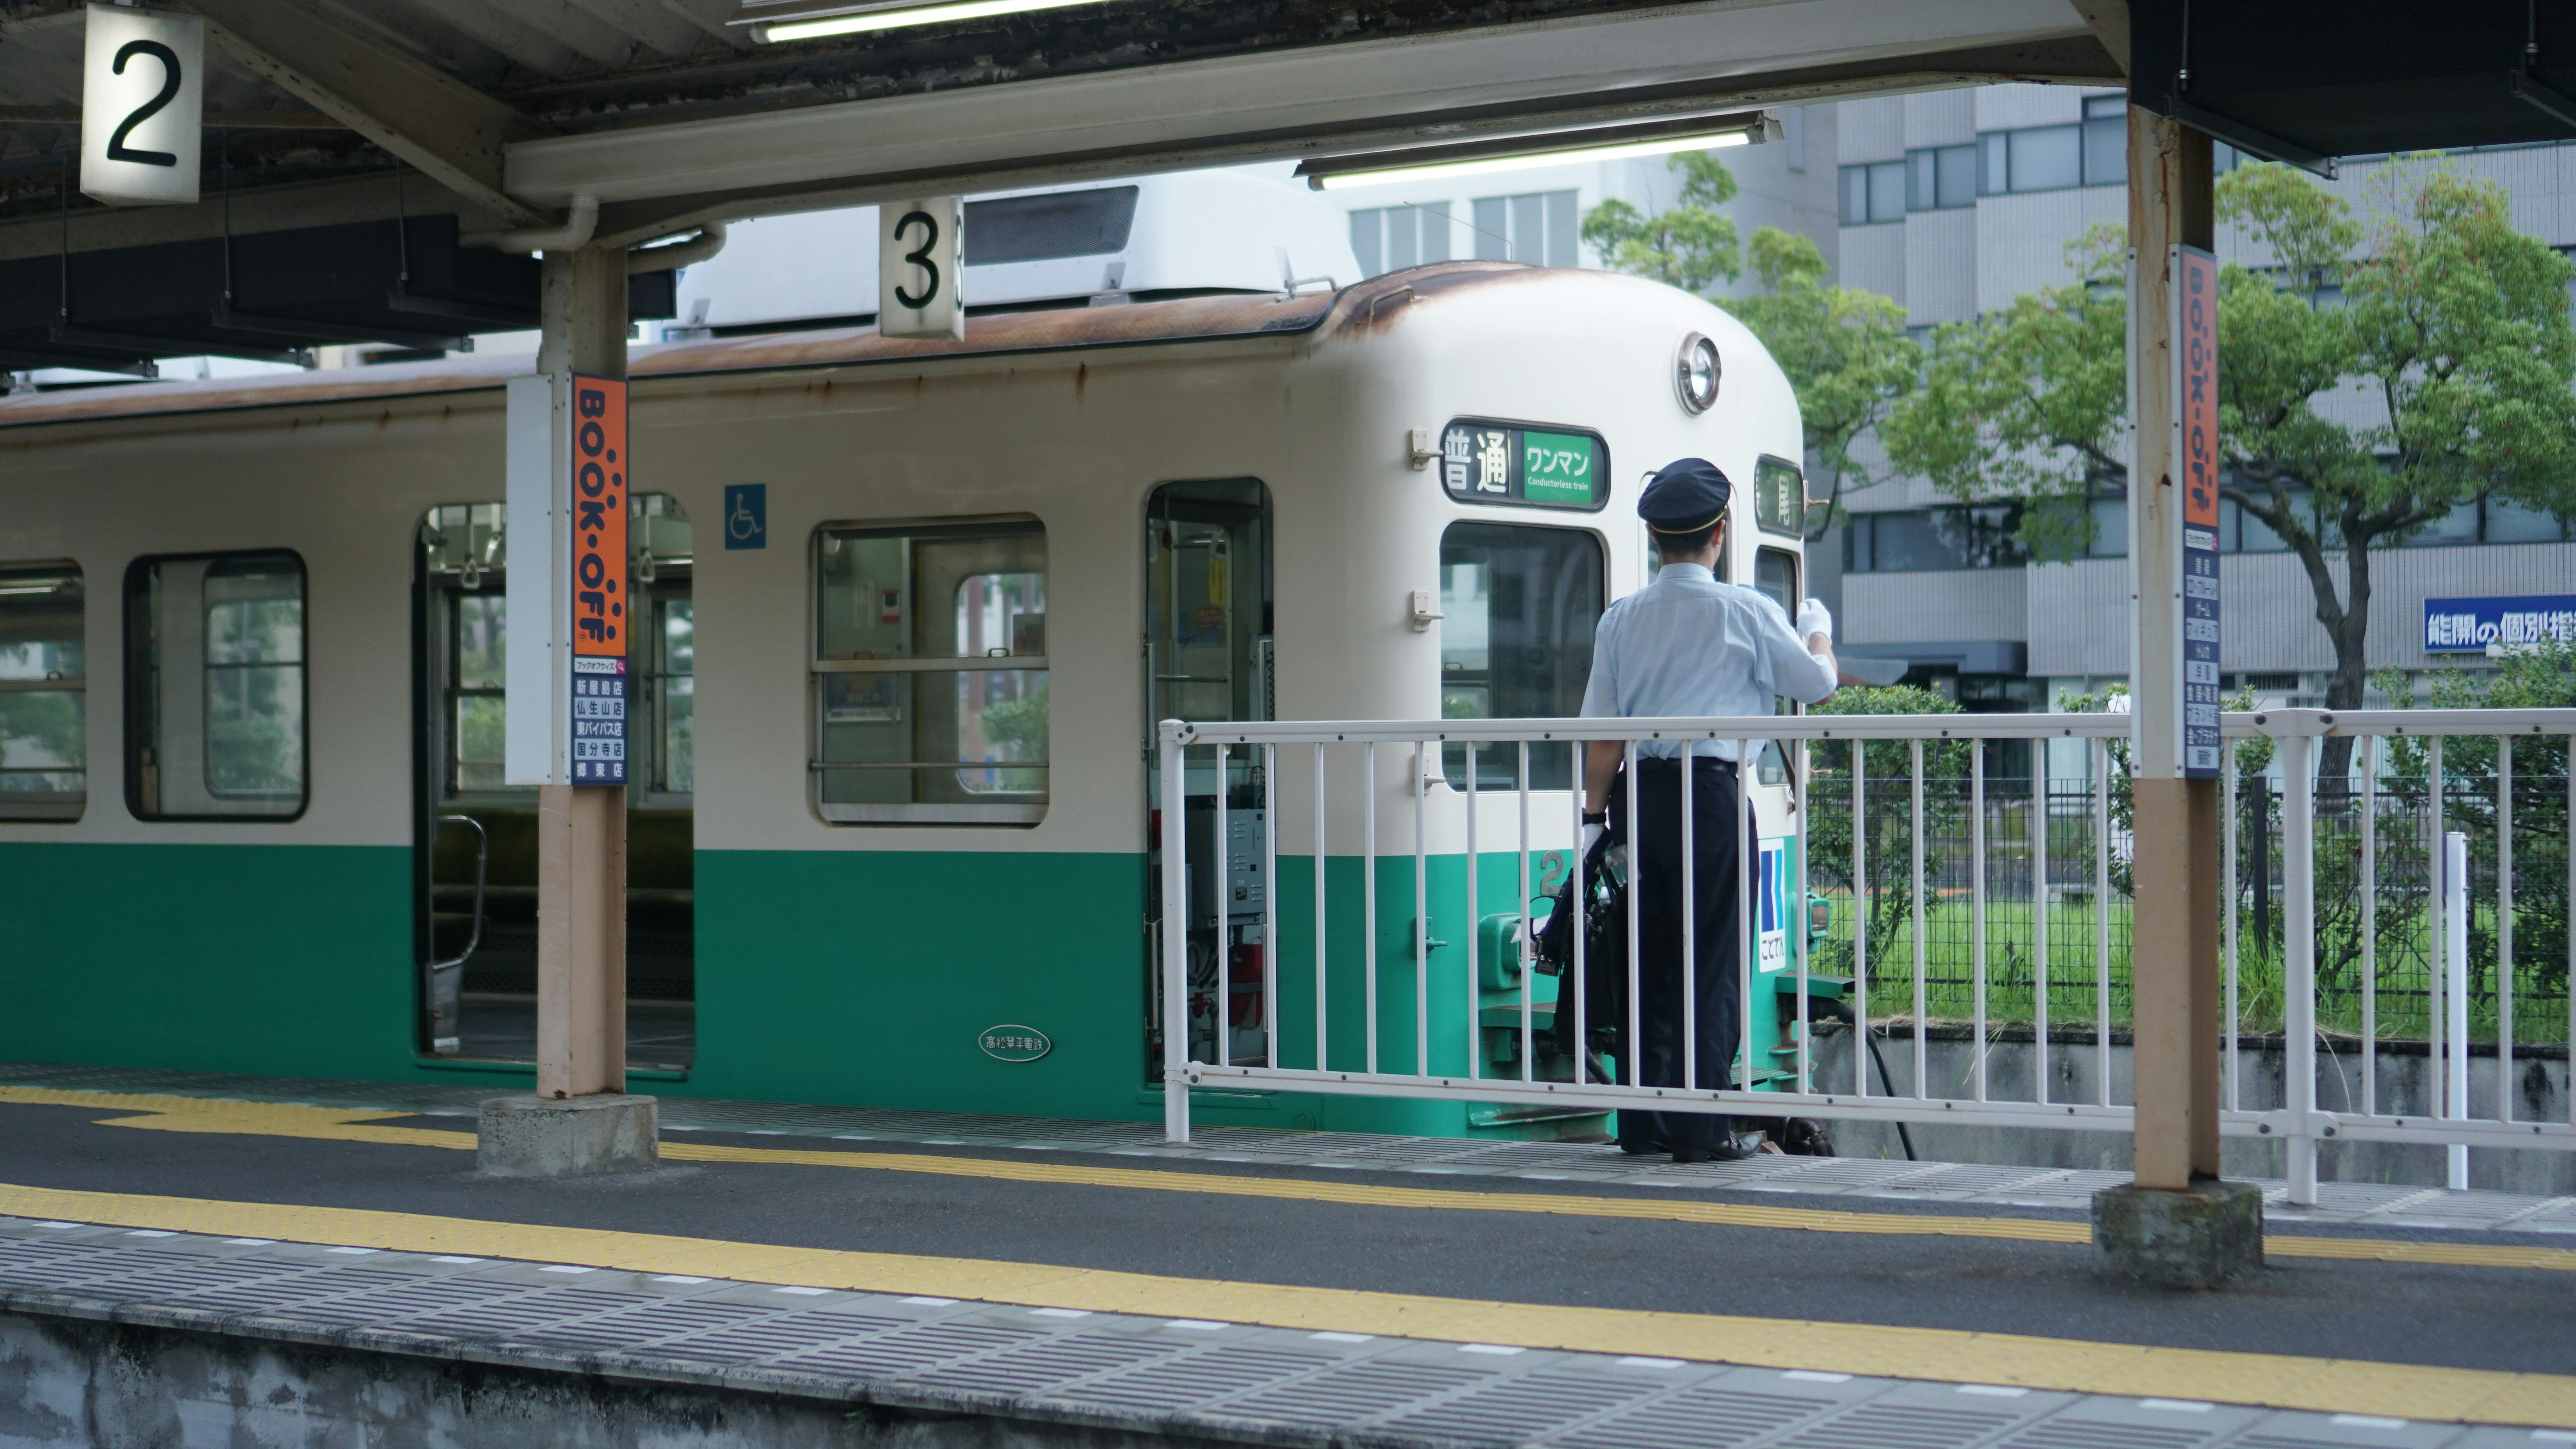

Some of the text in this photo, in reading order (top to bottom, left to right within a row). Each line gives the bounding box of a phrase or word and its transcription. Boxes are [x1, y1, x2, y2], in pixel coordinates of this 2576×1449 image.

[106, 39, 181, 167] 2
[894, 211, 939, 309] 3
[1446, 429, 1506, 493] 普通
[1527, 448, 1589, 476] ワンマン
[1528, 476, 1589, 491] Conductorless train
[2428, 610, 2576, 646] 能開の個別指
[577, 661, 614, 670] ブックオフウィズ
[577, 679, 622, 696] 新屋島店
[577, 700, 622, 715] 仏生山店
[577, 721, 622, 737] 東バイパス店
[577, 742, 622, 756] 国分寺店
